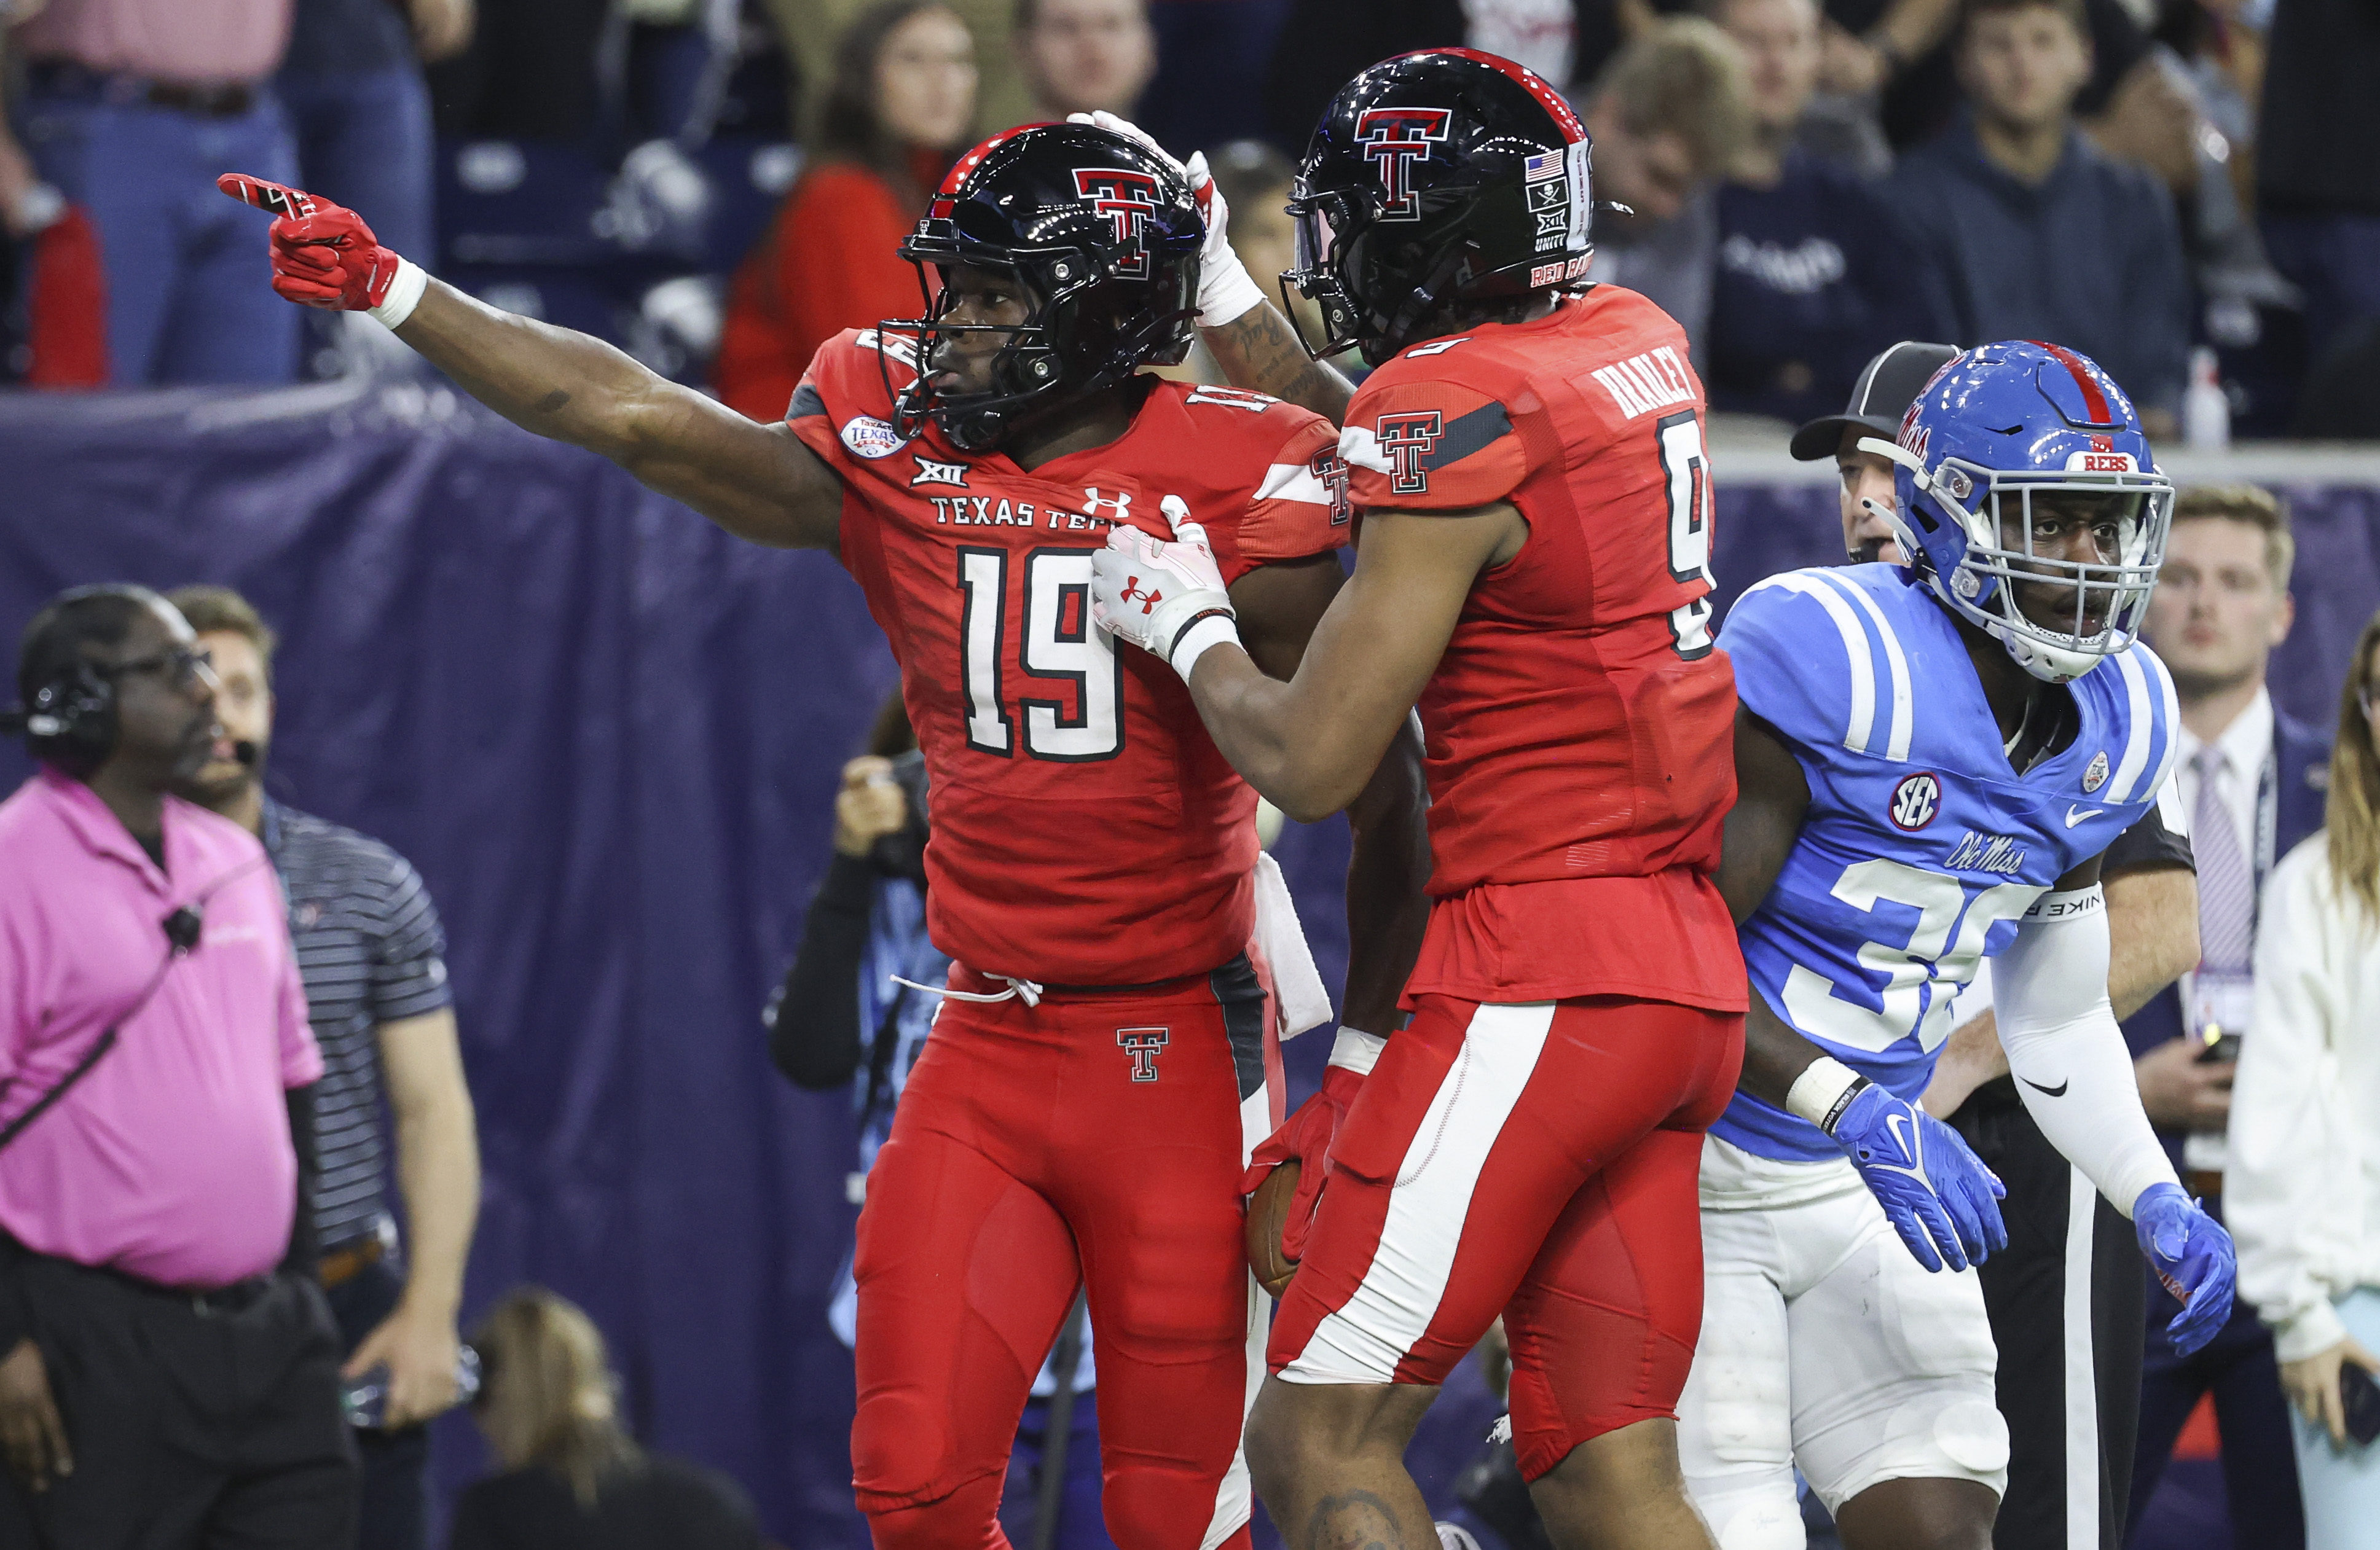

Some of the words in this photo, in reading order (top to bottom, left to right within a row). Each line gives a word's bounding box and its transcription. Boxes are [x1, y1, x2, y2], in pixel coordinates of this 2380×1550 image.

[1534, 233, 1566, 252] UNITY
[1531, 262, 1565, 288] RED
[1590, 345, 1697, 420] BRADLEY
[852, 427, 896, 444] TEXAS
[2084, 455, 2129, 472] REBS
[930, 496, 1035, 527] TEXAS
[957, 544, 1126, 763] 19
[1891, 775, 1939, 827] SEC
[1944, 829, 1984, 872] Ole
[1975, 834, 2025, 875] Miss
[2046, 892, 2100, 916] NIKE
[1833, 1093, 1850, 1112] BLACK
